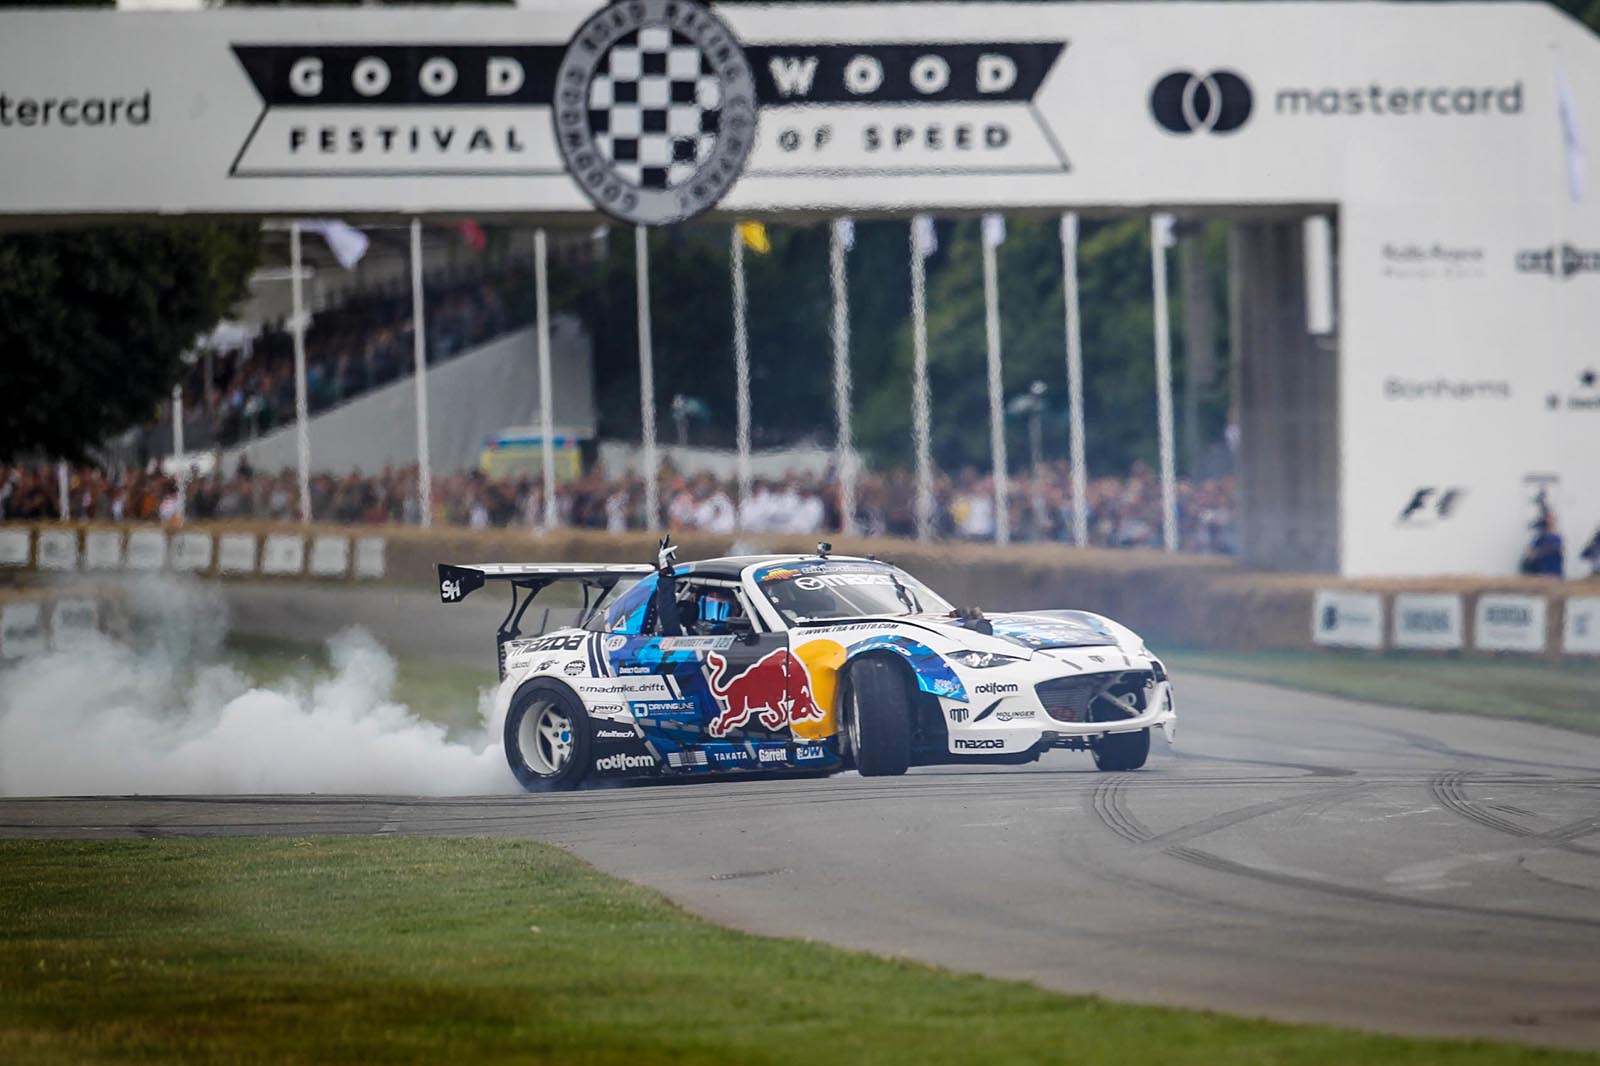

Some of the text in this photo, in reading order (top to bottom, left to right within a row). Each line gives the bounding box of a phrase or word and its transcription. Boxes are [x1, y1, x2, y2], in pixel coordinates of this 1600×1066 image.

[289, 54, 1018, 97] GOOD WOOD
[1275, 79, 1524, 115] mastercard
[290, 126, 1009, 152] FESTIVAL OF SPEED
[441, 580, 461, 601] SH
[975, 682, 1018, 695] rotiform
[597, 730, 635, 738] Haltech
[955, 739, 1004, 749] mazda
[596, 752, 655, 771] rotiform
[714, 752, 748, 761] TAKATA
[759, 748, 788, 762] Garrett
